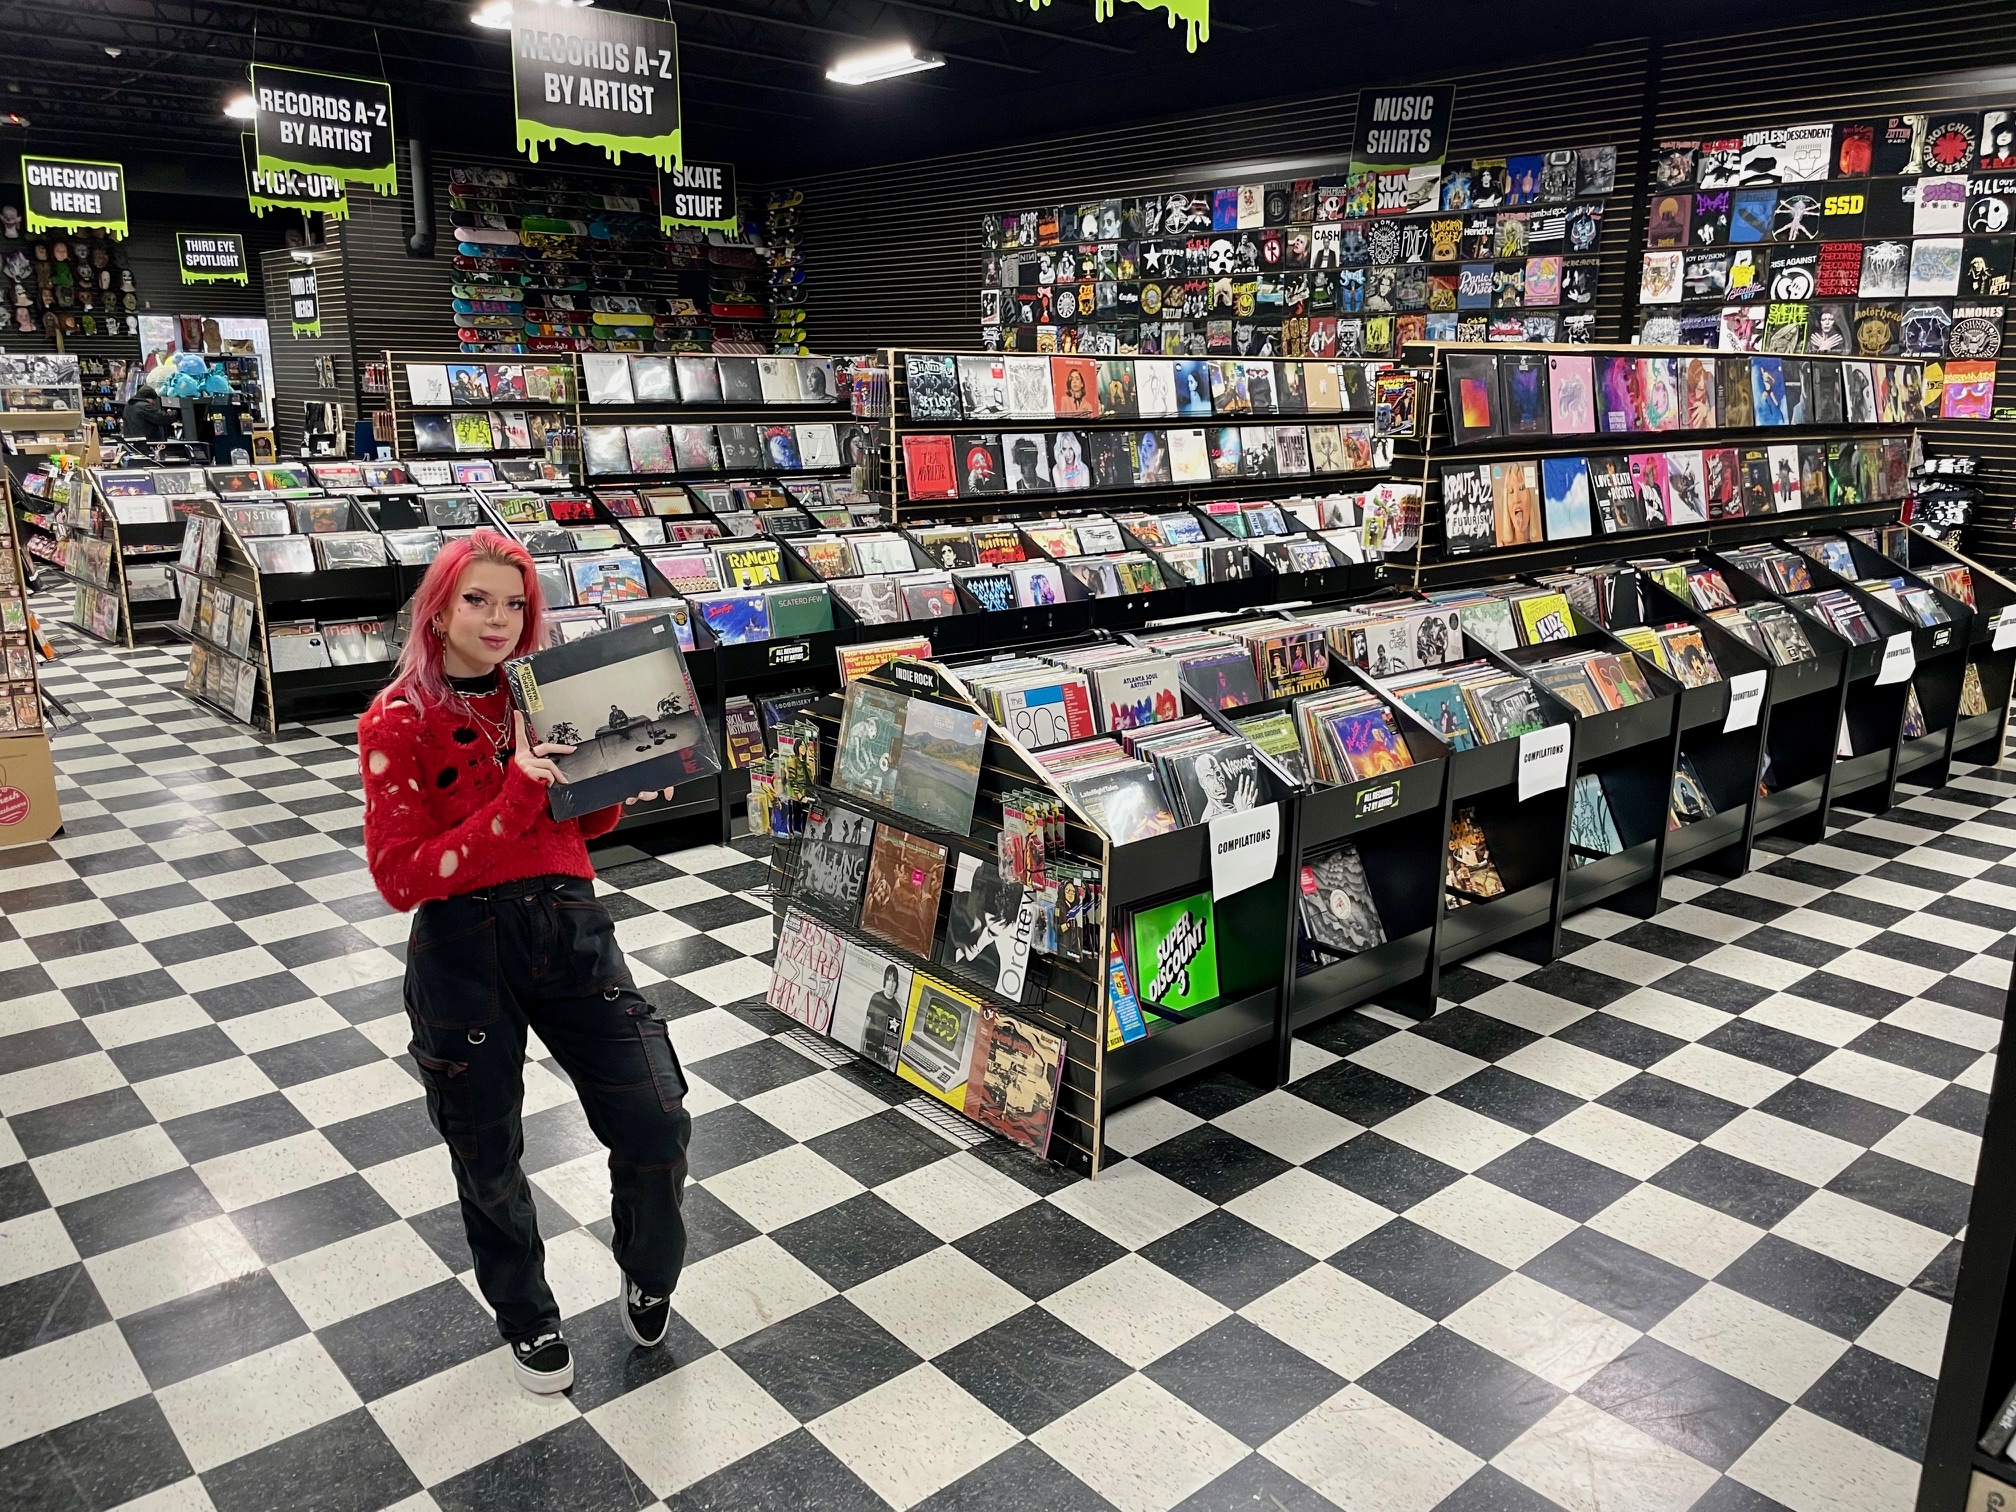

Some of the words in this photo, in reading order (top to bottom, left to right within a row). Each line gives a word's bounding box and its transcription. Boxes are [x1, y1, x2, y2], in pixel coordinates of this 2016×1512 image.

[520, 28, 630, 74] RECORDS
[635, 46, 673, 80] A-Z
[545, 73, 574, 105] BY
[579, 79, 655, 116] ARTIST
[259, 88, 351, 122] RECORDS
[354, 102, 388, 127] A-Z
[1373, 96, 1434, 122] MUSIC
[280, 121, 307, 145] BY
[309, 125, 372, 154] ARTIST
[1366, 128, 1432, 154] SHIRTS
[1925, 124, 1946, 146] HOT
[1923, 145, 1938, 169] RED
[27, 165, 119, 192] CHECKOUT
[673, 165, 722, 190] SKATE
[1999, 179, 2016, 187] OUT
[1966, 178, 2001, 197] FALL
[51, 191, 102, 214] HERE!
[675, 194, 722, 218] STUFF
[1824, 195, 1864, 216] SSD
[1314, 230, 1340, 242] CASH
[185, 239, 215, 252] THIRD
[217, 241, 235, 253] EYE
[1820, 243, 1863, 252] 7SECONDS
[186, 254, 239, 267] SPOTLIGHT
[1697, 252, 1726, 261] DIVISION
[1770, 258, 1786, 269] RISE
[1786, 255, 1818, 267] AGAINST
[1818, 252, 1861, 261] 7SECONDS
[289, 278, 305, 295] THIRD
[306, 276, 316, 294] EYE
[1953, 307, 2003, 319] RAMONES
[919, 395, 933, 408] SET
[934, 396, 952, 408] LIST
[1596, 474, 1611, 488] LOVE
[1612, 472, 1632, 486] DEATH
[729, 549, 780, 568] RANCID
[1536, 611, 1563, 637] KIDZ
[895, 667, 914, 683] INDIE
[913, 671, 934, 688] ROCK
[1123, 675, 1145, 685] ATLANTA
[1146, 672, 1158, 681] SOUL
[1130, 680, 1153, 690] ARTISTRY
[1010, 696, 1023, 706] the
[1732, 688, 1759, 702] SOUNDTRACKS
[726, 712, 745, 725] SOCIAL
[727, 721, 760, 736] DISTORTION
[878, 752, 890, 771] 6
[1524, 744, 1564, 763] COMPILATIONS
[1363, 792, 1372, 803] ALL
[1372, 786, 1394, 799] RECORDS
[1217, 829, 1271, 855] COMPILATIONS
[1156, 911, 1191, 968] SUPER
[780, 932, 841, 981] LIZARD
[1149, 918, 1206, 1001] DISCOUNT
[1176, 968, 1190, 996] 3
[769, 974, 830, 1031] HEAD
